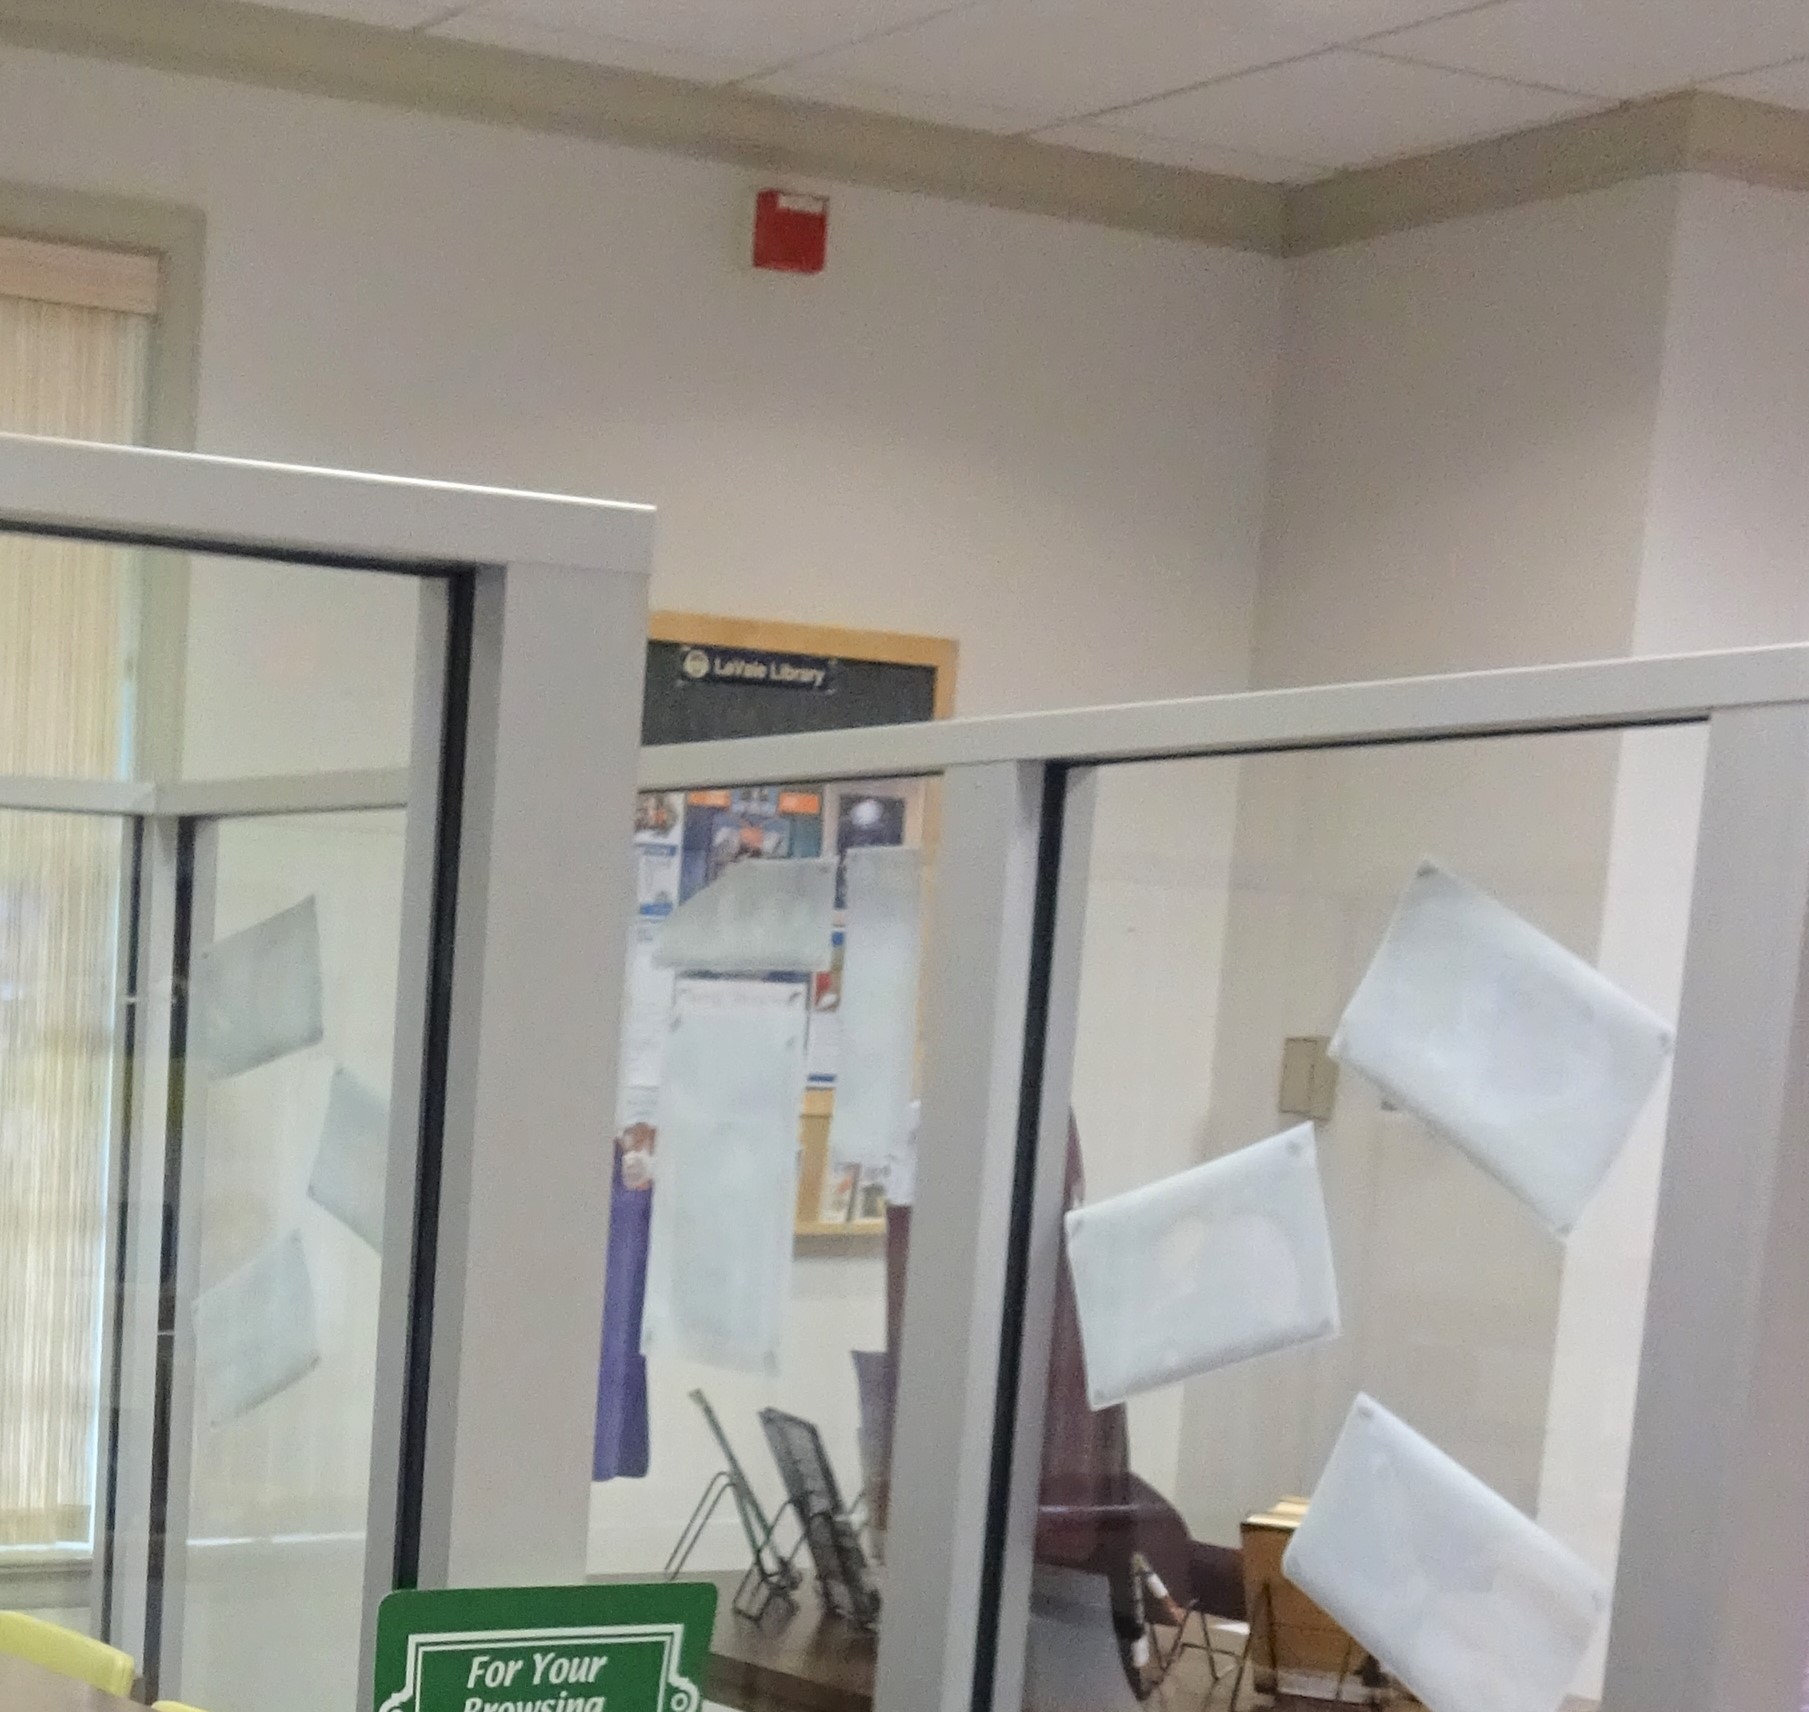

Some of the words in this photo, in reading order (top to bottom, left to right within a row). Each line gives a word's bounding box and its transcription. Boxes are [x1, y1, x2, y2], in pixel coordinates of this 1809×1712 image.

[770, 661, 825, 688] Library
[466, 1656, 524, 1689] For
[532, 1652, 608, 1685] Your
